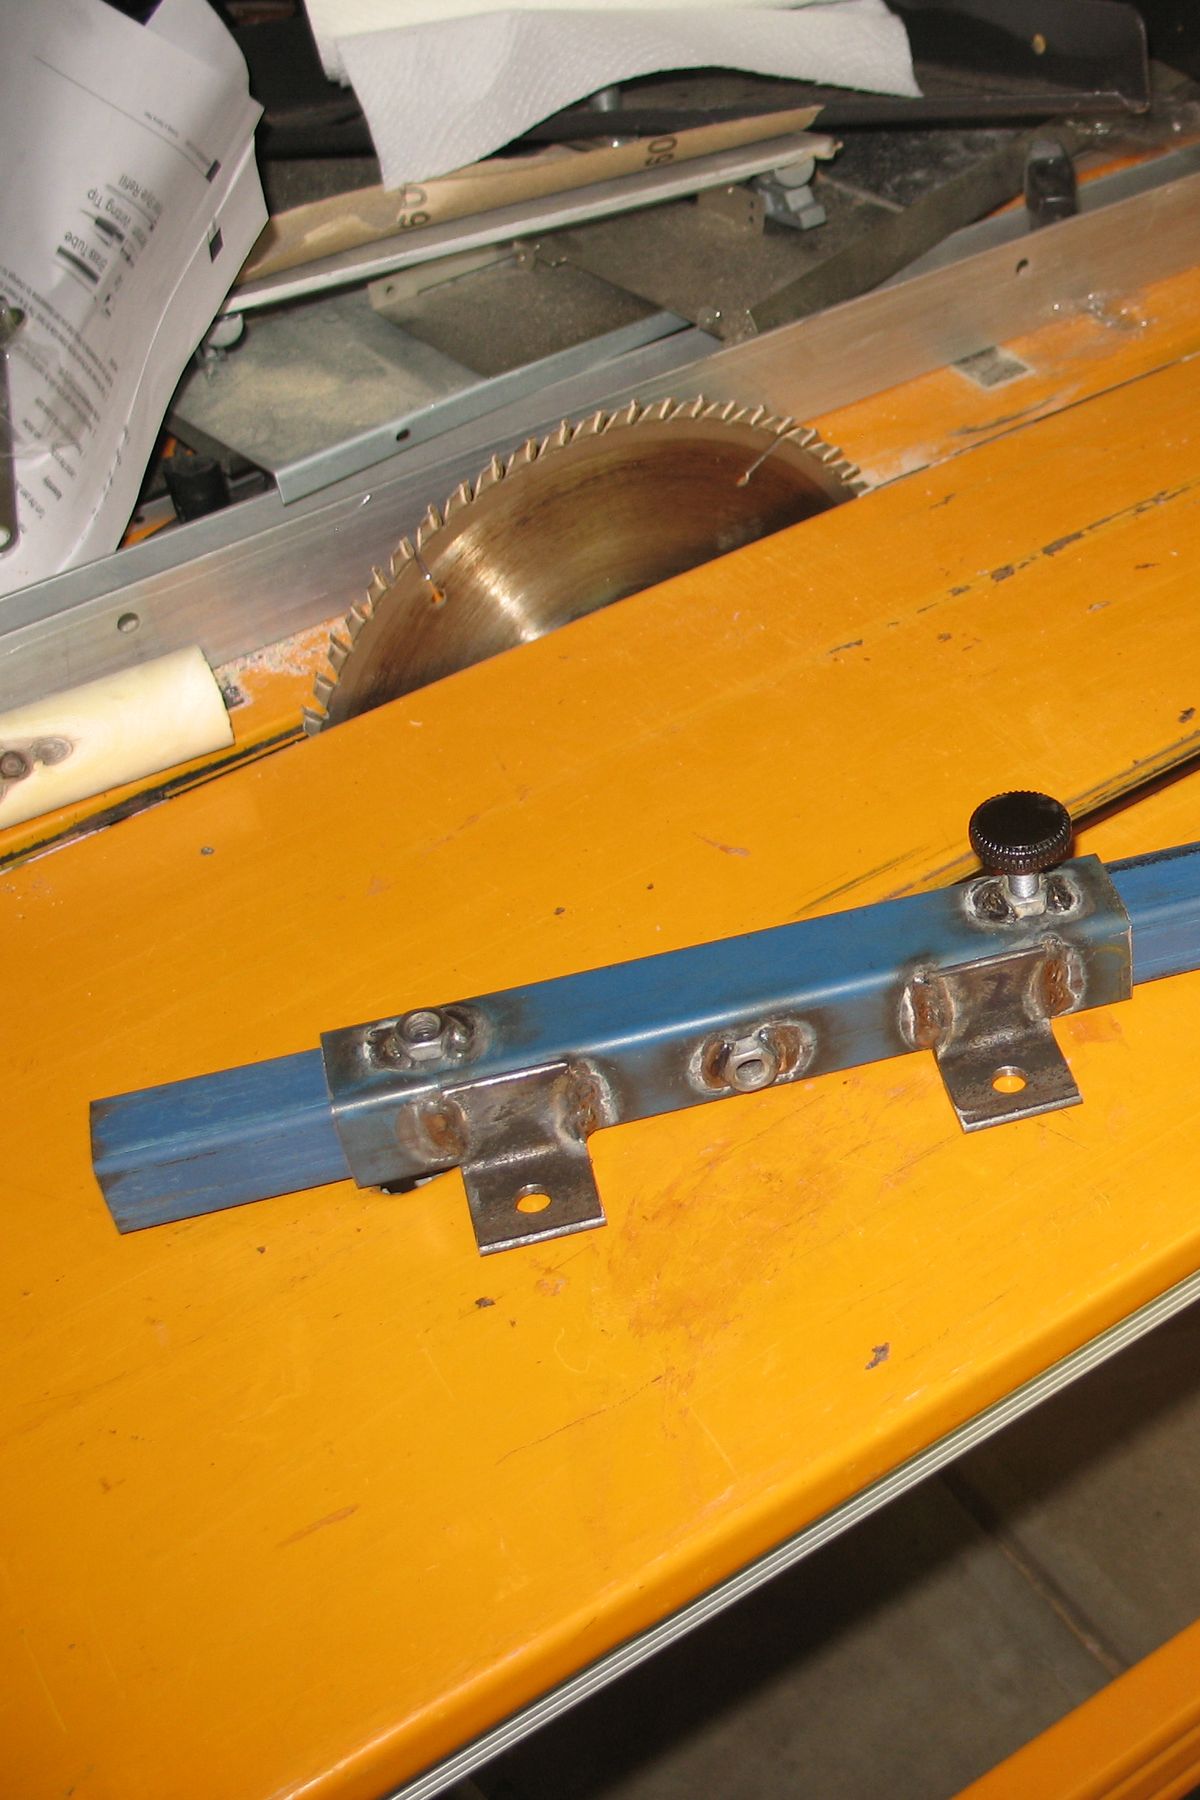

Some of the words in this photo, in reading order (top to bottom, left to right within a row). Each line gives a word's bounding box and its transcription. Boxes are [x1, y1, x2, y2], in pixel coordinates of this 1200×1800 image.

[644, 135, 678, 168] 60
[87, 187, 103, 208] Tip
[399, 183, 431, 229] 60
[64, 231, 88, 256] Tube
